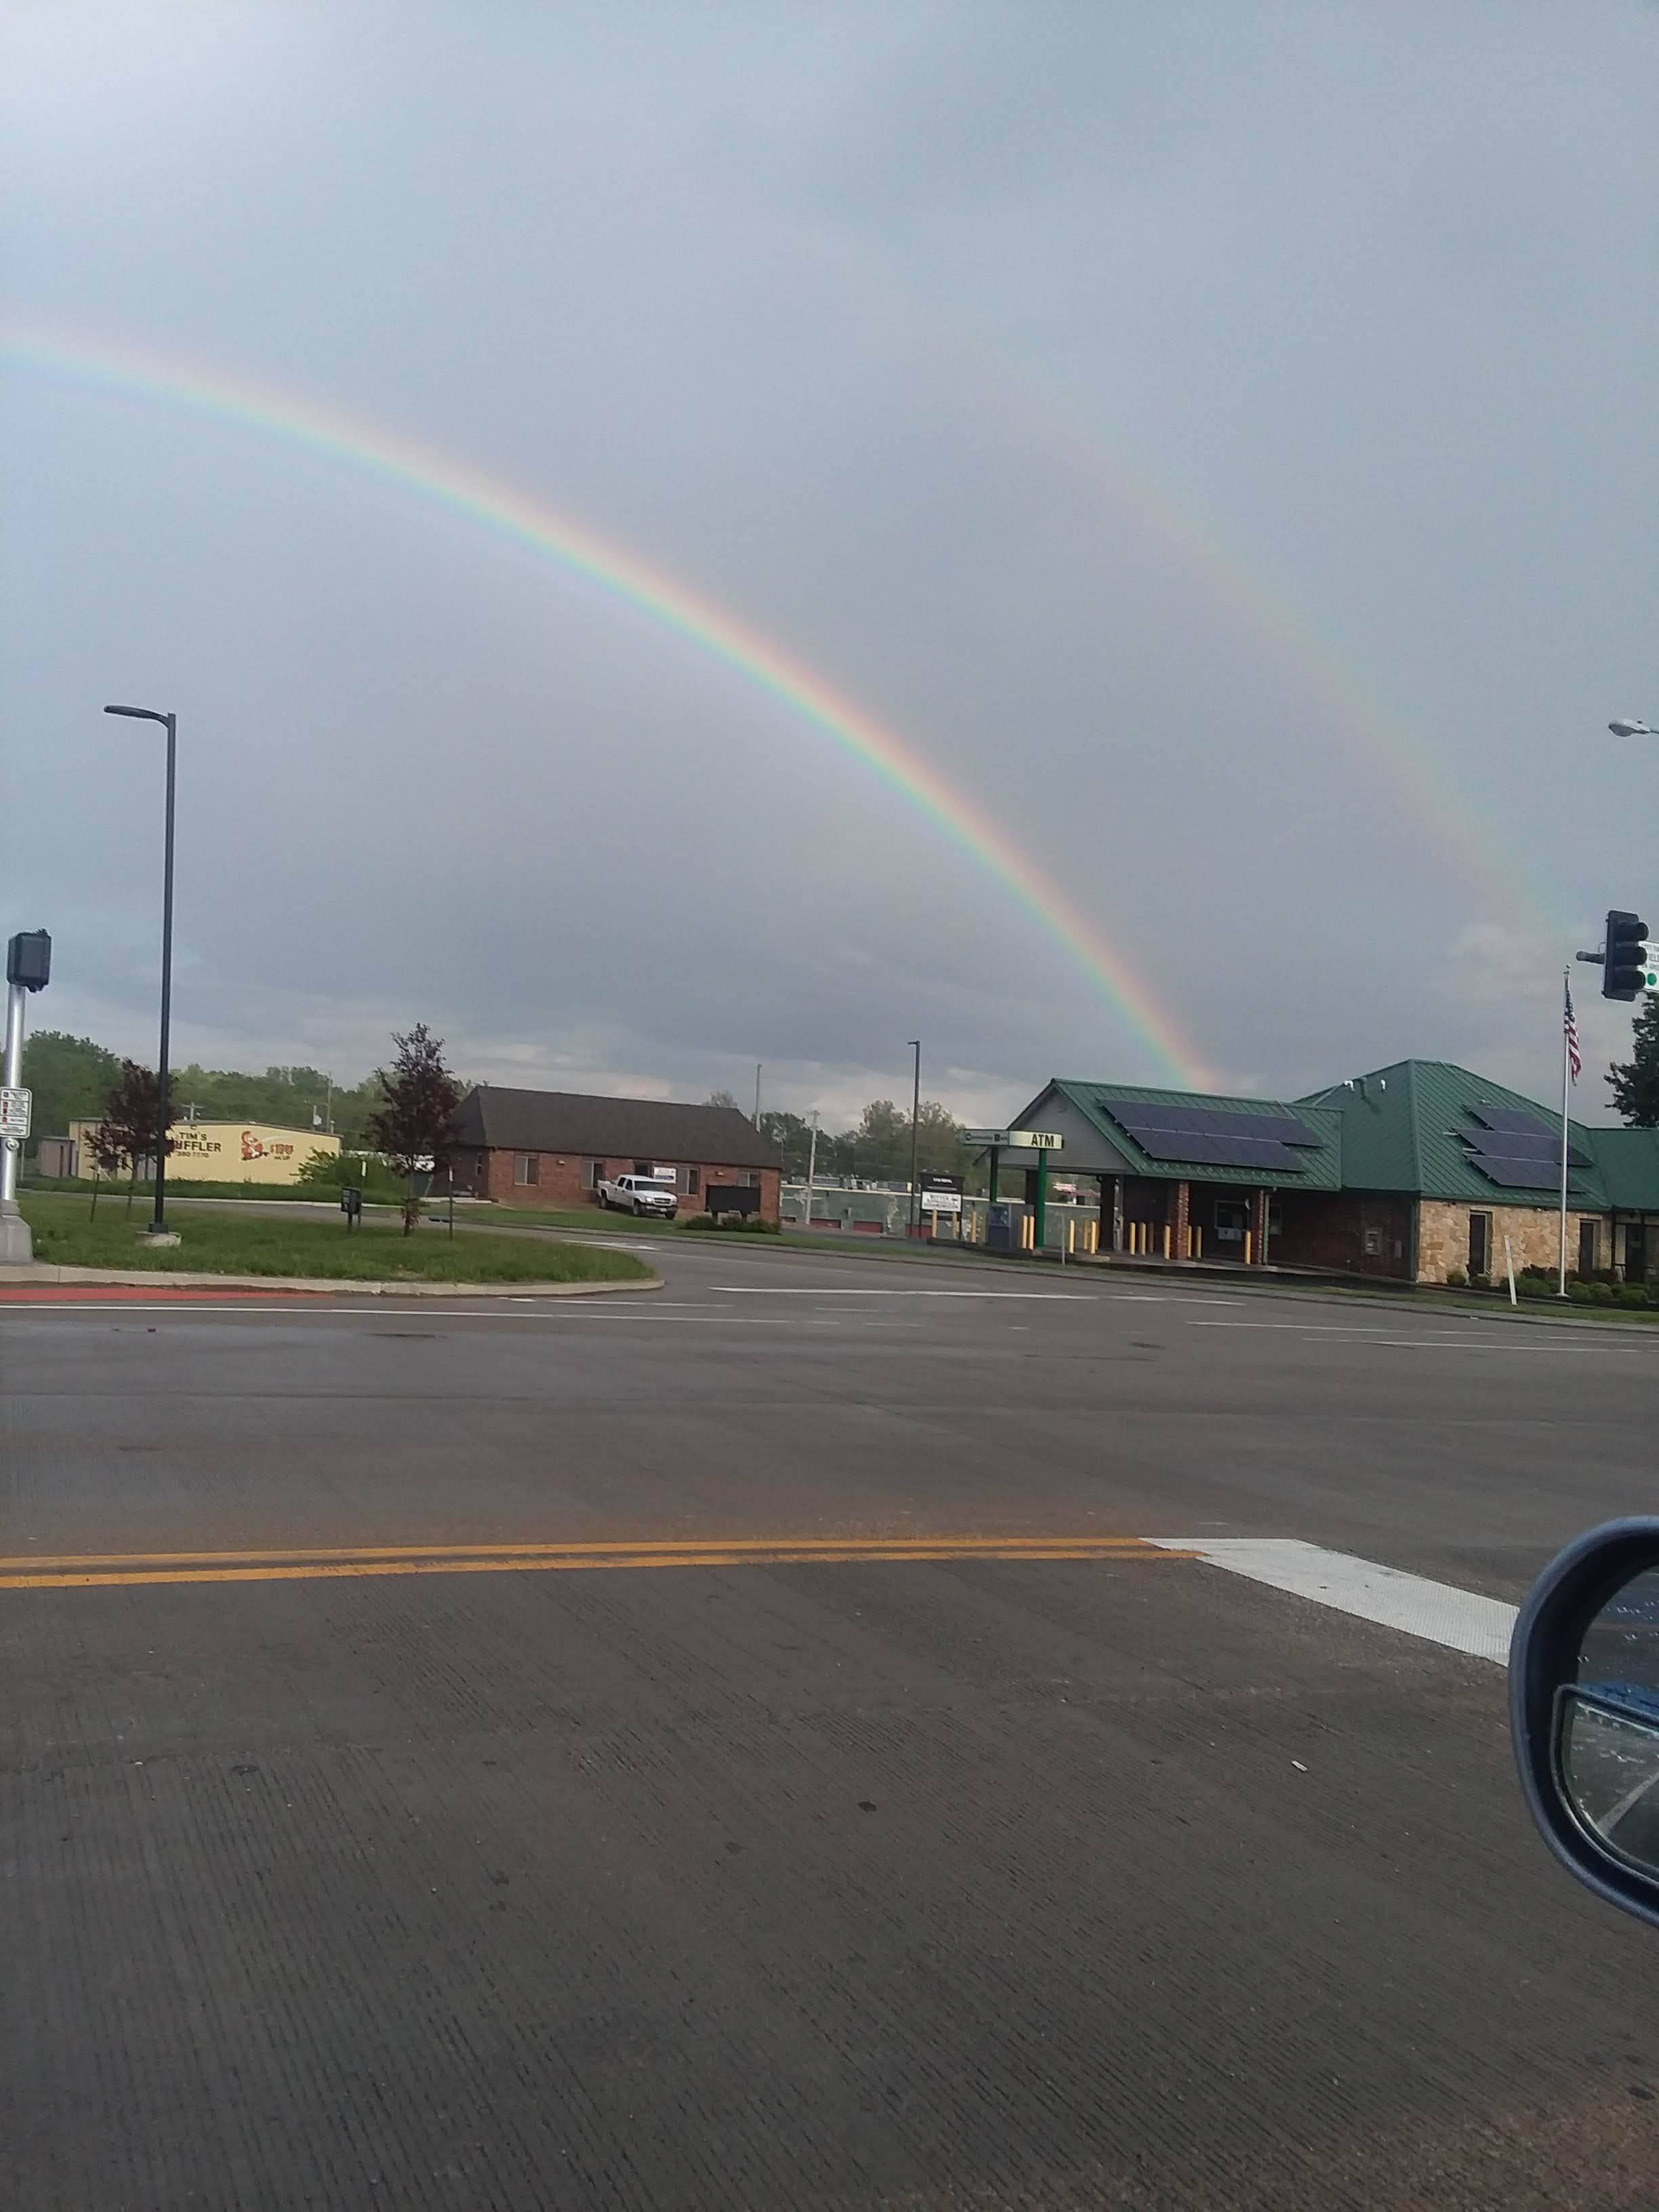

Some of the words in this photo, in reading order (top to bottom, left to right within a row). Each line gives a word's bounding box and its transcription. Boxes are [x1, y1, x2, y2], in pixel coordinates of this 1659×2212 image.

[179, 1132, 207, 1141] TIM'S
[1031, 1134, 1054, 1147] ATM
[168, 1141, 222, 1152] UFFLER
